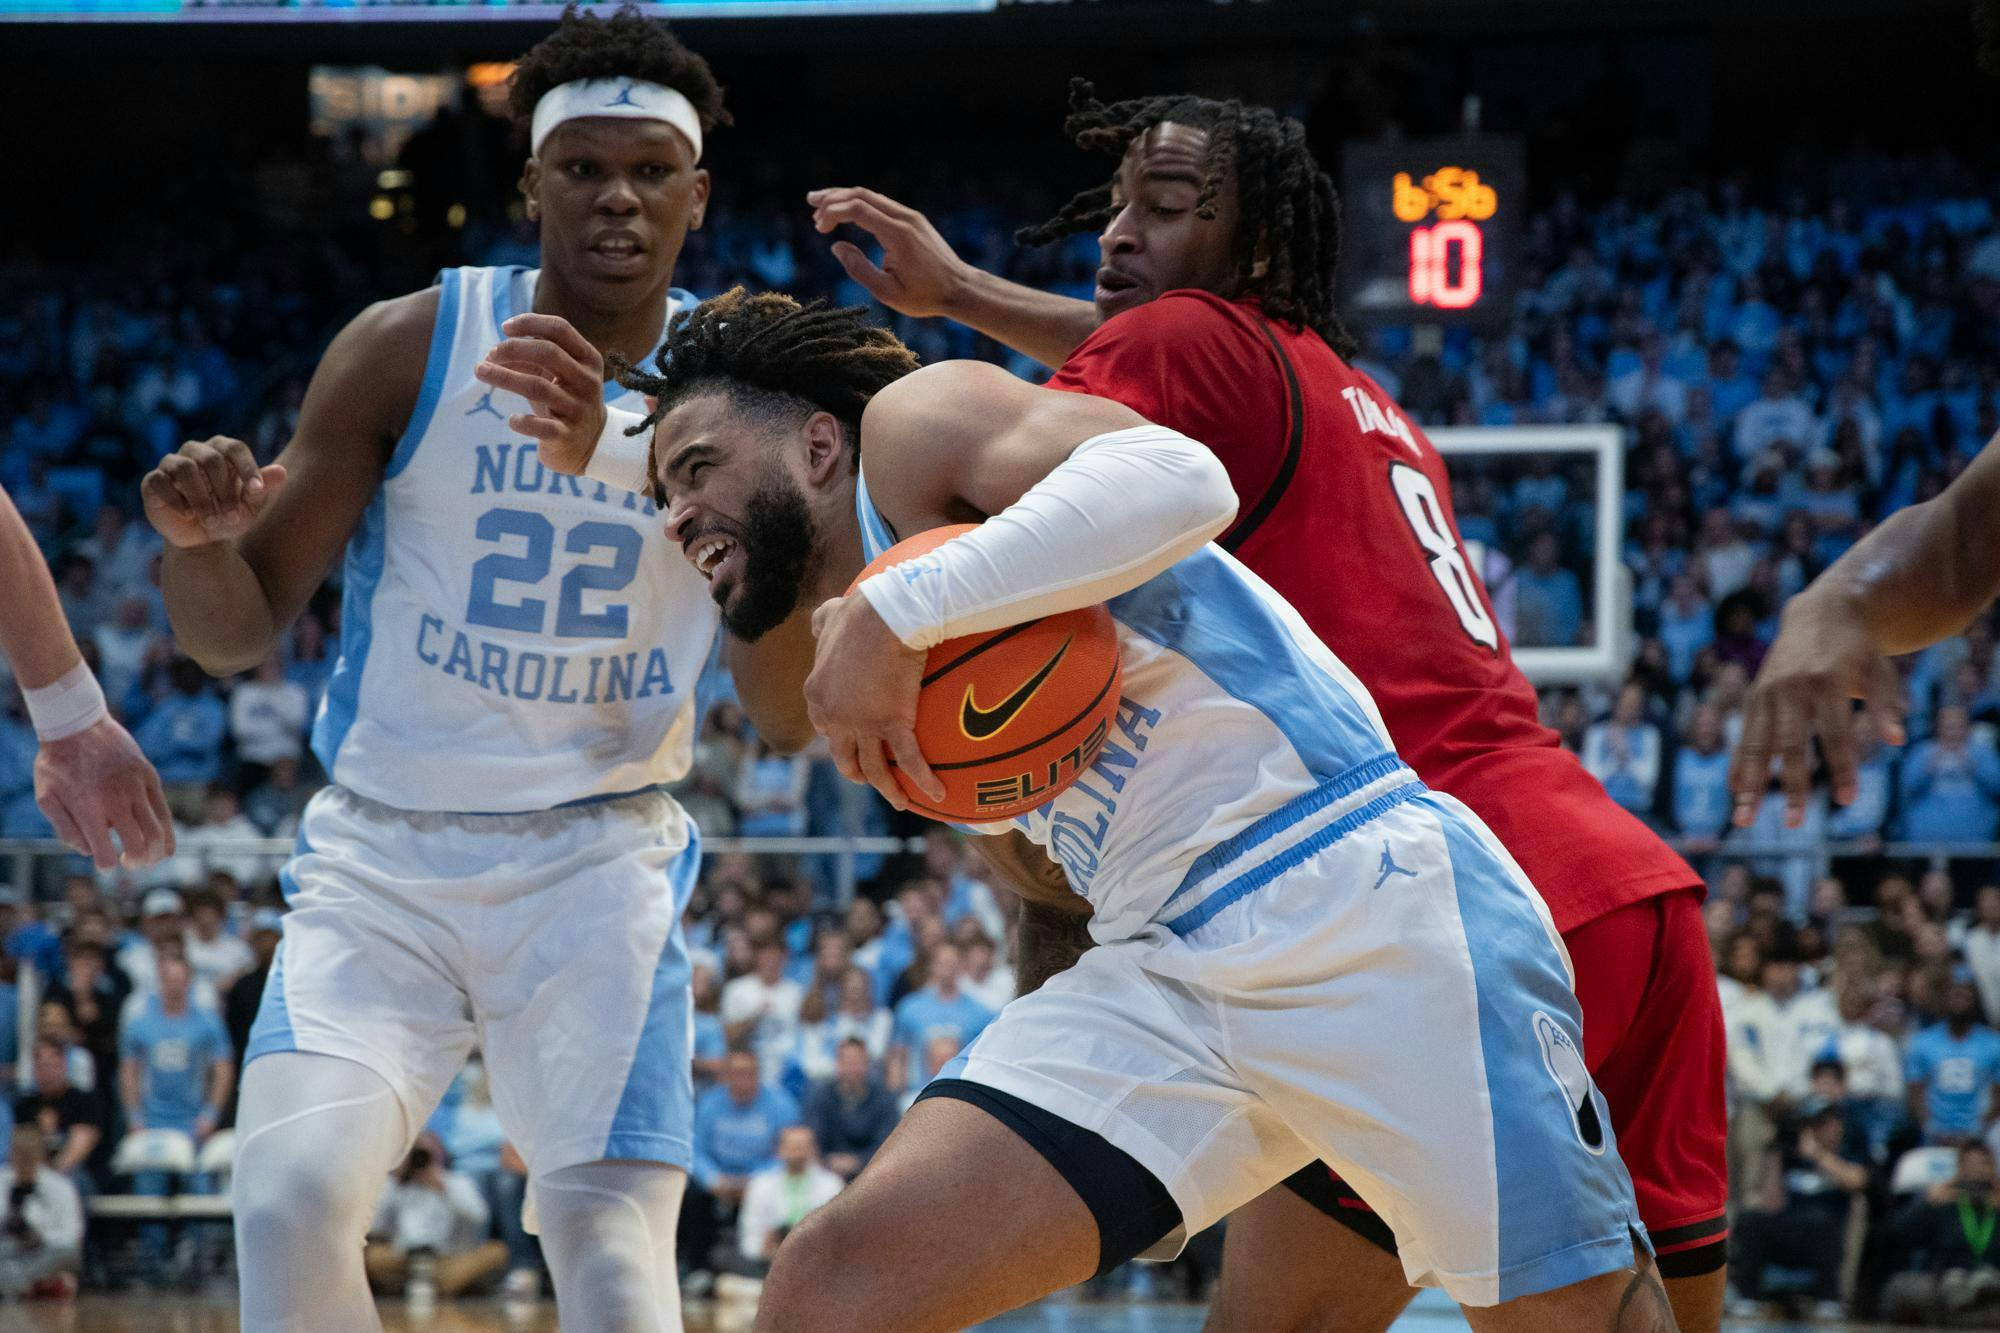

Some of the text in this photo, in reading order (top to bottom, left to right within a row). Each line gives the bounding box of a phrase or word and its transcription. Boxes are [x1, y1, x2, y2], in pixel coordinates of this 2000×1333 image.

[1410, 220, 1482, 309] 10
[466, 507, 644, 638] 22
[1389, 459, 1498, 653] 8
[416, 613, 675, 703] CAROLINA
[976, 716, 1107, 806] ELITE
[1052, 695, 1161, 897] ROLINA
